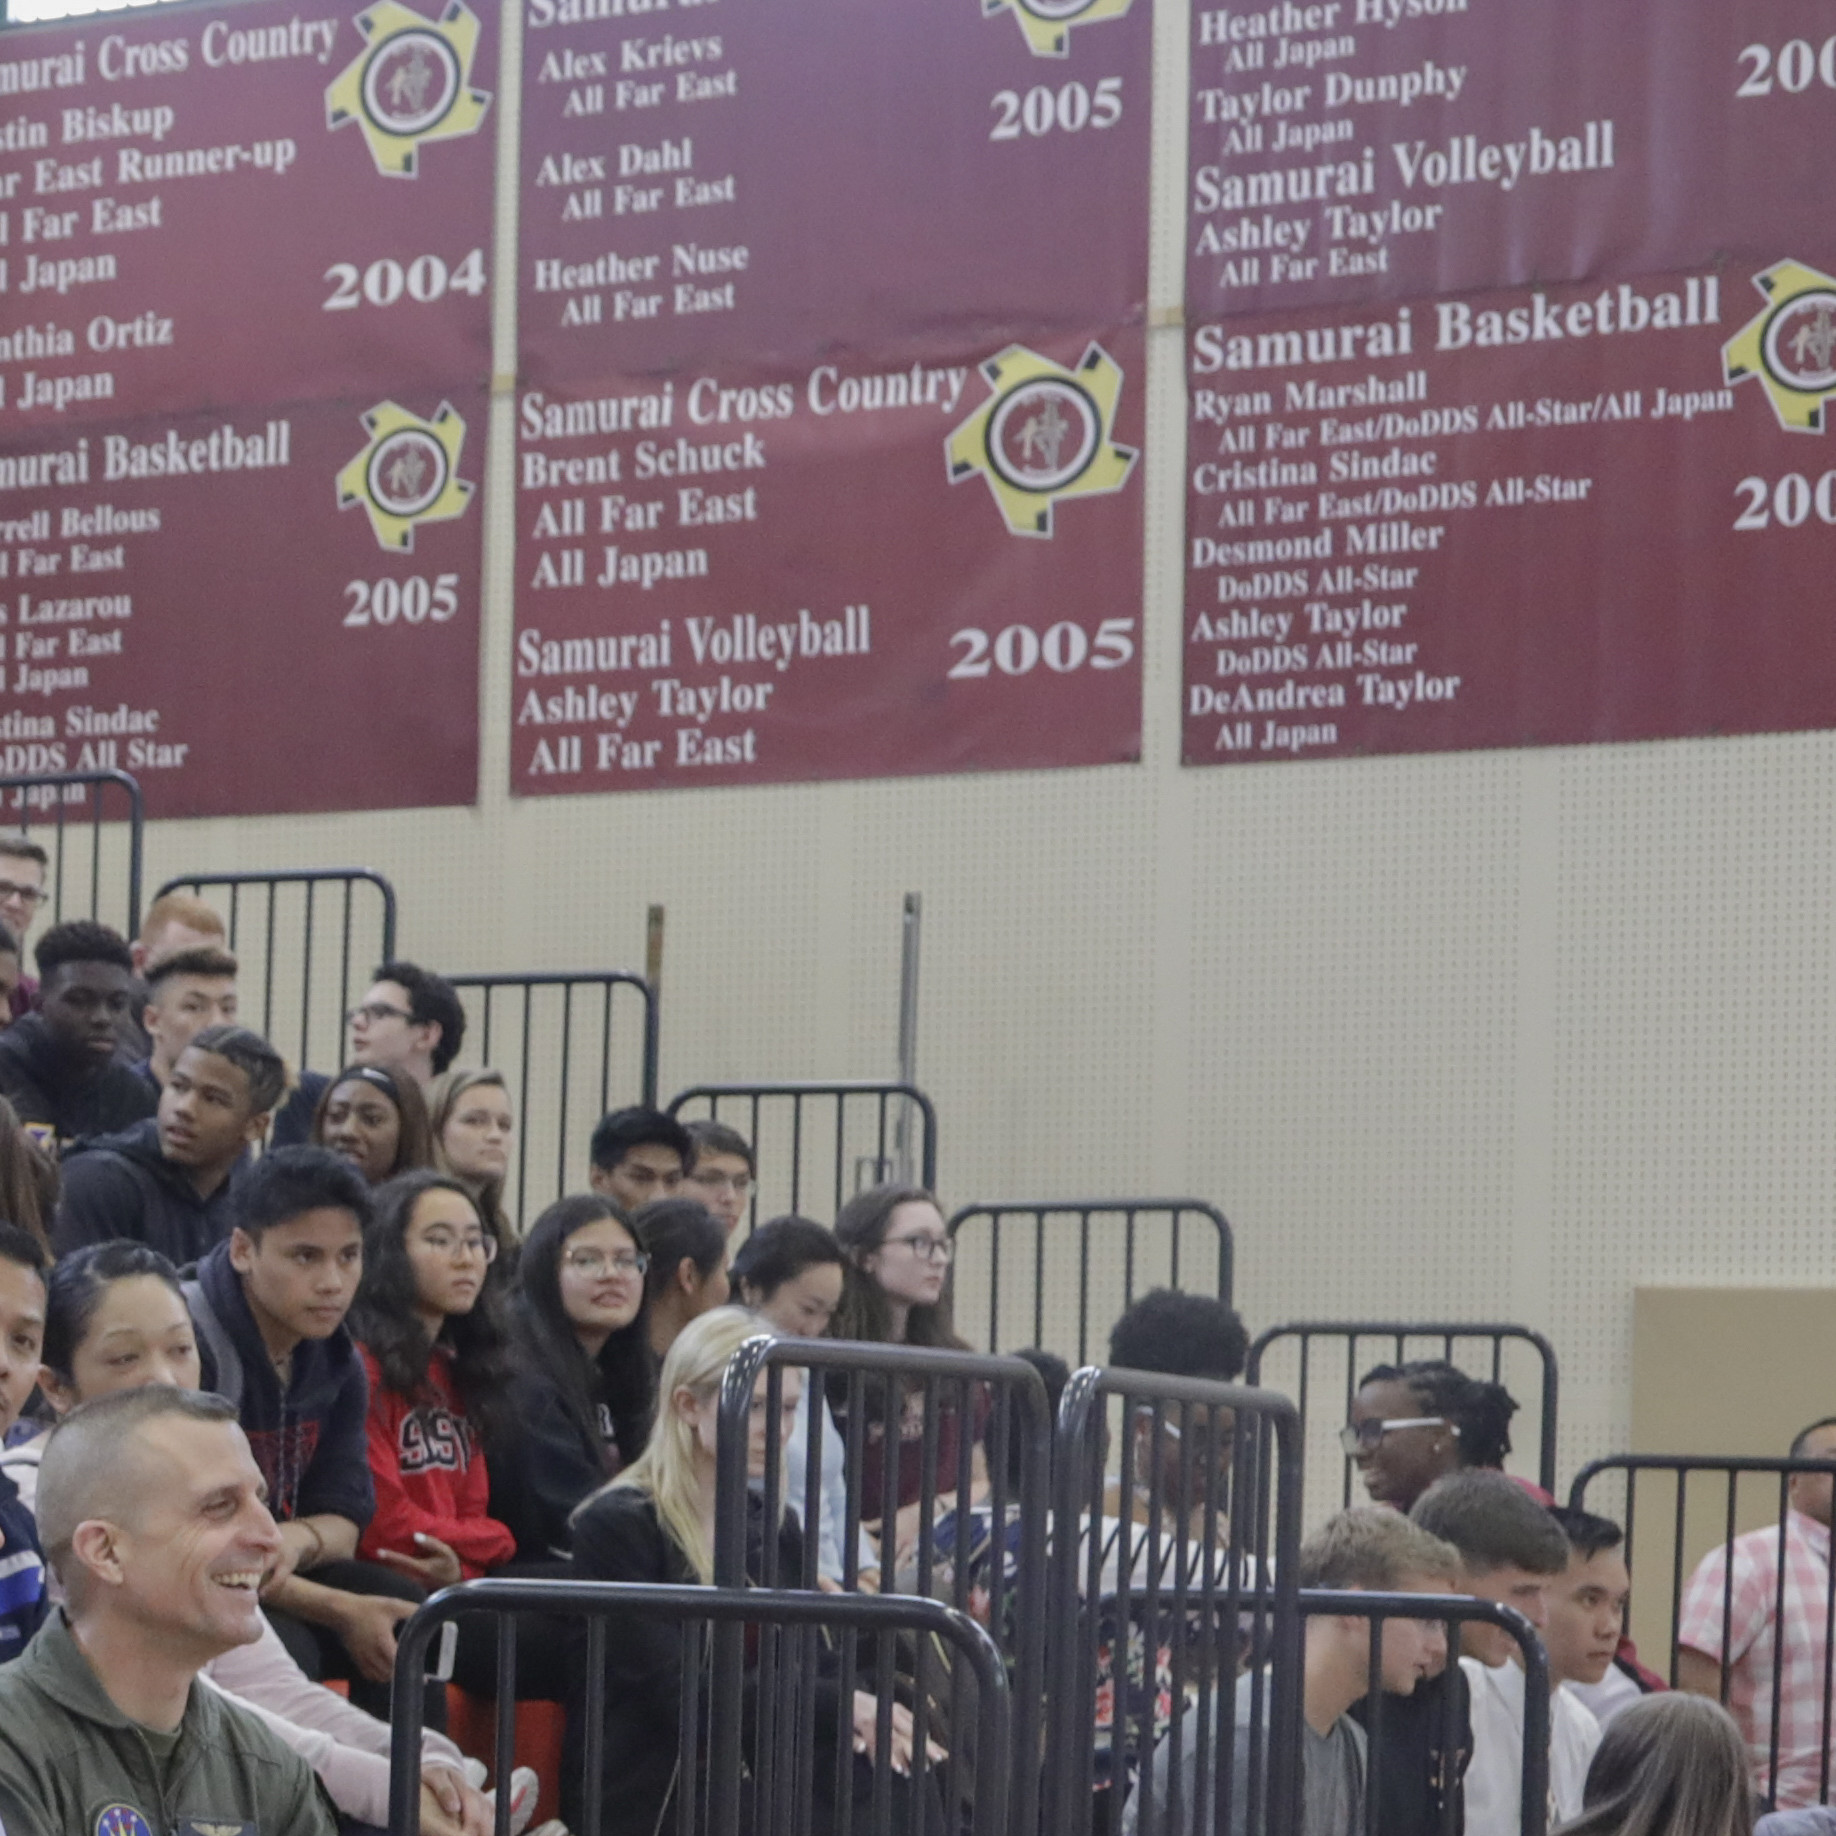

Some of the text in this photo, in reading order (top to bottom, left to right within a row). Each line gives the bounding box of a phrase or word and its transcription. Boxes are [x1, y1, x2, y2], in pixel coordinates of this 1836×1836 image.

[1200, 1, 1340, 45] Heather
[98, 35, 188, 80] Cross
[201, 17, 337, 67] Country
[539, 49, 606, 82] Alex
[1225, 36, 1355, 72] All Japan
[565, 70, 736, 116] All Far East
[991, 77, 1122, 139] 2005
[1197, 61, 1466, 127] Taylor Dunphy
[62, 103, 174, 143] Biskup
[1223, 119, 1353, 155] All Japan
[35, 157, 102, 193] East
[118, 139, 296, 183] Runner-up
[536, 137, 691, 186] Alex Dahl
[1195, 120, 1613, 212] Samurai Volleyball
[23, 208, 79, 242] Far
[92, 196, 161, 233] East
[563, 175, 734, 220] All Far East
[1196, 200, 1443, 255] Ashley Taylor
[20, 255, 116, 294] Japan
[323, 249, 486, 310] 2004
[536, 243, 748, 291] Heather Nuse
[1220, 246, 1388, 287] All Far East
[562, 283, 734, 325] All Far East
[1193, 276, 1719, 373] Samurai Basketball
[87, 311, 172, 351] Ortiz
[17, 372, 113, 411] Japan
[522, 362, 966, 440] Samurai Cross Country
[1195, 370, 1426, 425] Ryan Marshall
[1219, 426, 1255, 453] All
[1265, 423, 1310, 450] Far
[1651, 388, 1733, 420] Japan
[105, 420, 289, 480] Basketball
[523, 431, 765, 489] Brent Schuck
[1193, 458, 1317, 494] Cristina
[61, 504, 160, 537] Bellous
[533, 487, 756, 538] All Far East
[1218, 500, 1254, 528] All
[1265, 497, 1309, 524] Far
[1486, 475, 1592, 505] All-Star
[18, 549, 61, 576] Far
[71, 544, 124, 572] East
[533, 546, 707, 589] All Japan
[1193, 521, 1444, 568] Desmond Miller
[344, 574, 457, 626] 2005
[1219, 564, 1418, 602] DoDDS All-Star
[19, 594, 131, 624] Lazarou
[1192, 599, 1407, 643] Ashley Taylor
[16, 632, 59, 659] Far
[69, 628, 121, 656] East
[518, 605, 869, 676] Samurai Volleyball
[948, 618, 1134, 678] 2005
[1217, 640, 1417, 676] DoDDS All-Star
[14, 664, 88, 696] Japan
[519, 676, 773, 727] Ashley Taylor
[1190, 671, 1460, 715] DeAndrea Taylor
[76, 740, 117, 773] All
[128, 738, 188, 768] Star
[530, 728, 755, 774] All Far East
[1216, 720, 1337, 752] All Japan
